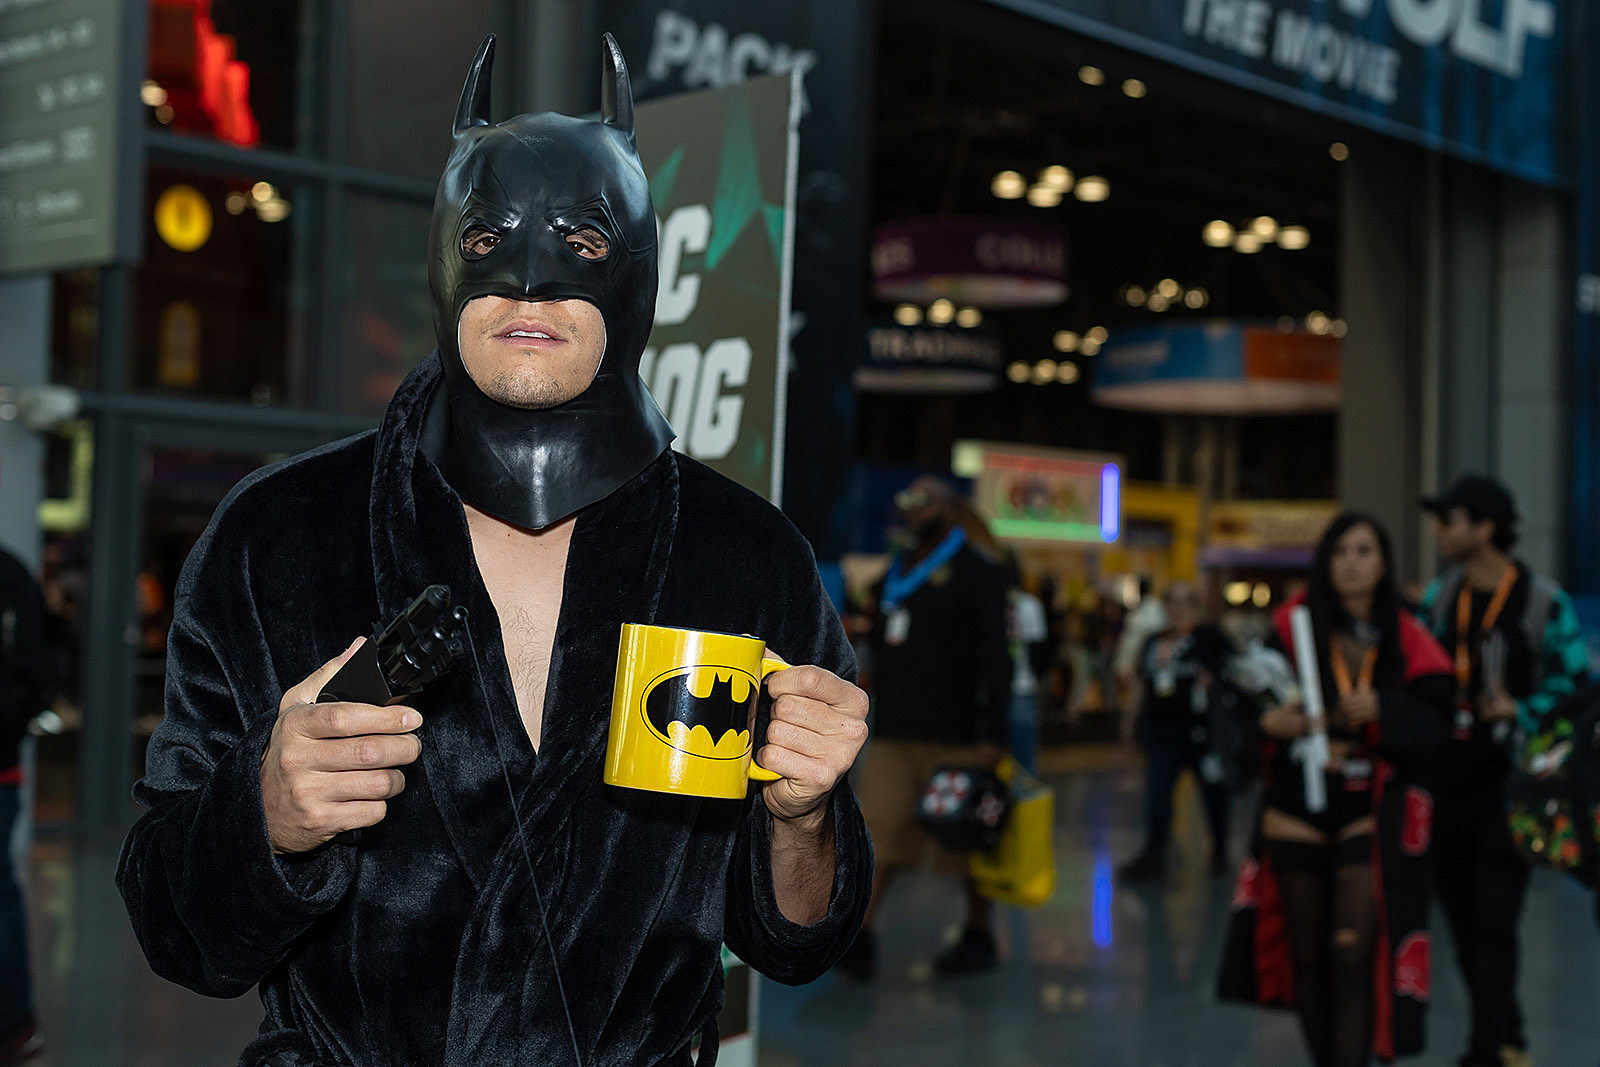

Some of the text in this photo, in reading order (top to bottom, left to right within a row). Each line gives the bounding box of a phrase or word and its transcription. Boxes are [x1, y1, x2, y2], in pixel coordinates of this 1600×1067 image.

[1272, 10, 1400, 104] MOVIE
[1338, 0, 1556, 79] LF
[655, 203, 712, 326] C
